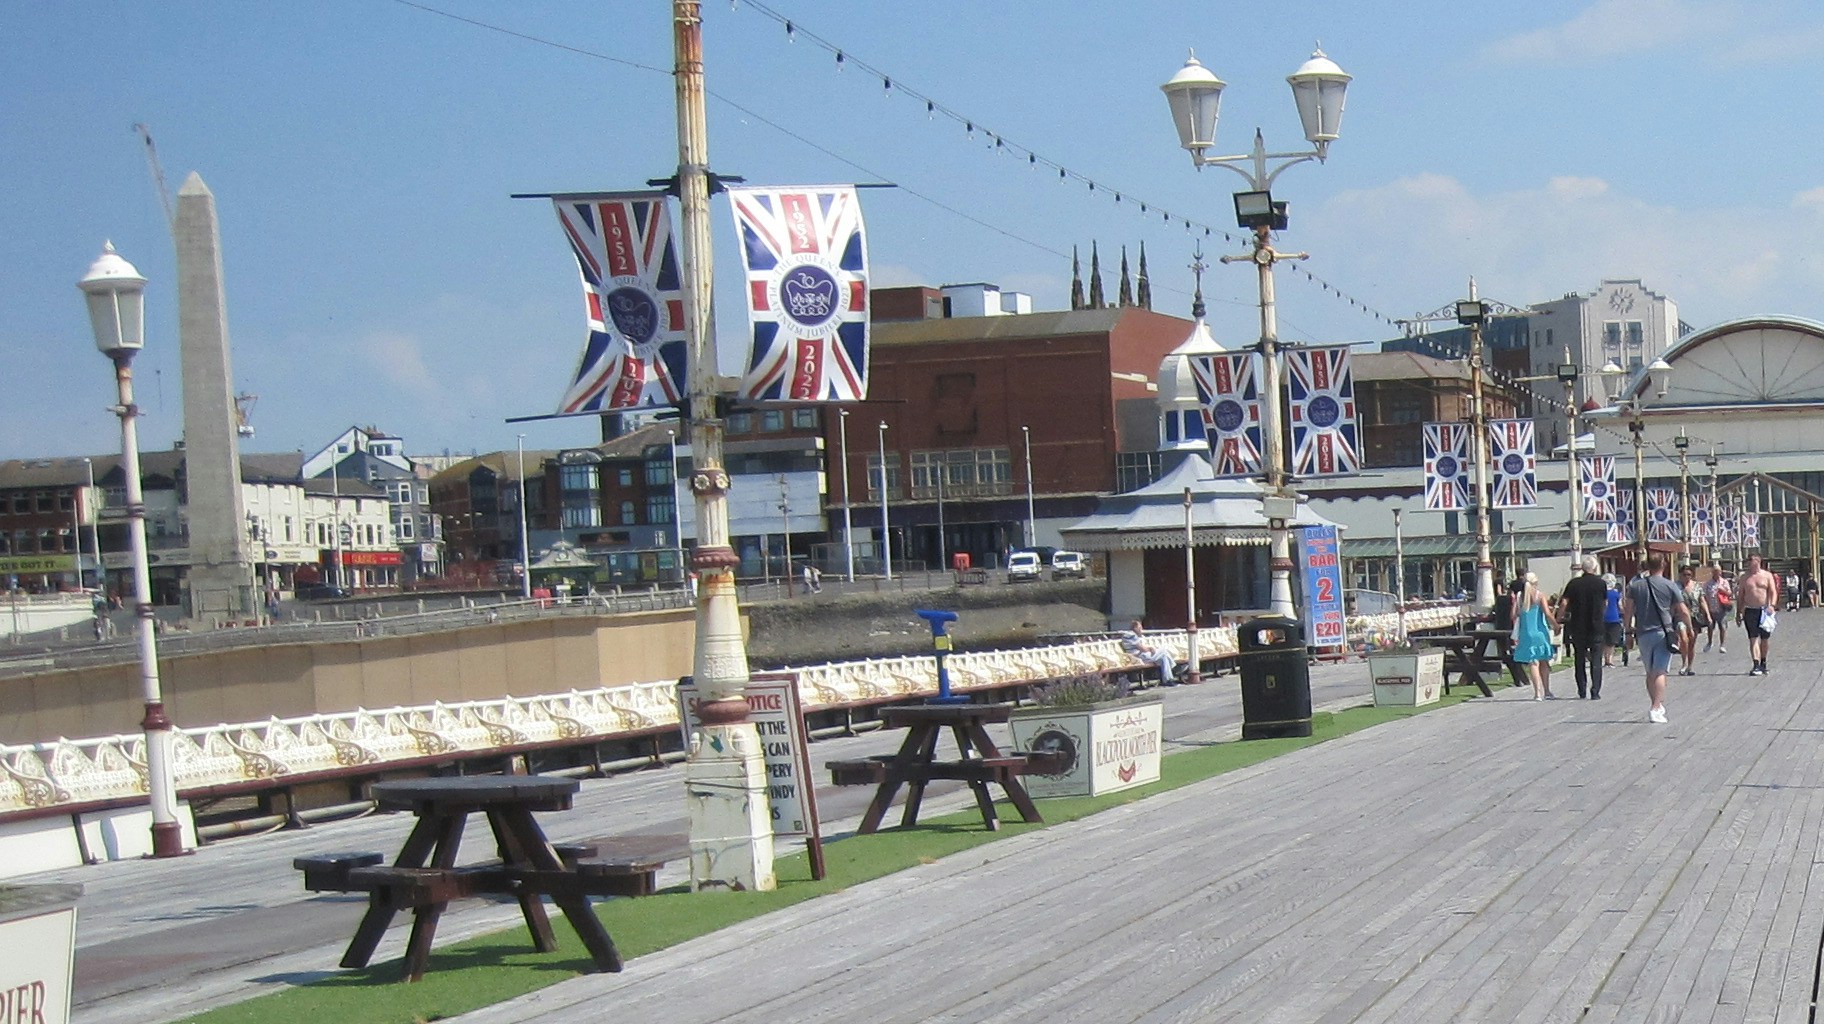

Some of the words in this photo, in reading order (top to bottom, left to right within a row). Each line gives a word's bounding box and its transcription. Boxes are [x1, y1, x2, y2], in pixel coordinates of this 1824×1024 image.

[792, 200, 810, 249] 1952
[610, 212, 628, 270] 1952
[1219, 361, 1229, 392] 1952
[1316, 355, 1326, 388] 1952
[1308, 553, 1337, 568] BAR
[1316, 577, 1335, 603] 2
[1315, 621, 1342, 638] £20
[746, 694, 783, 711] OTICE
[766, 720, 787, 735] THE
[768, 741, 791, 756] CAN
[770, 784, 795, 799] INDY
